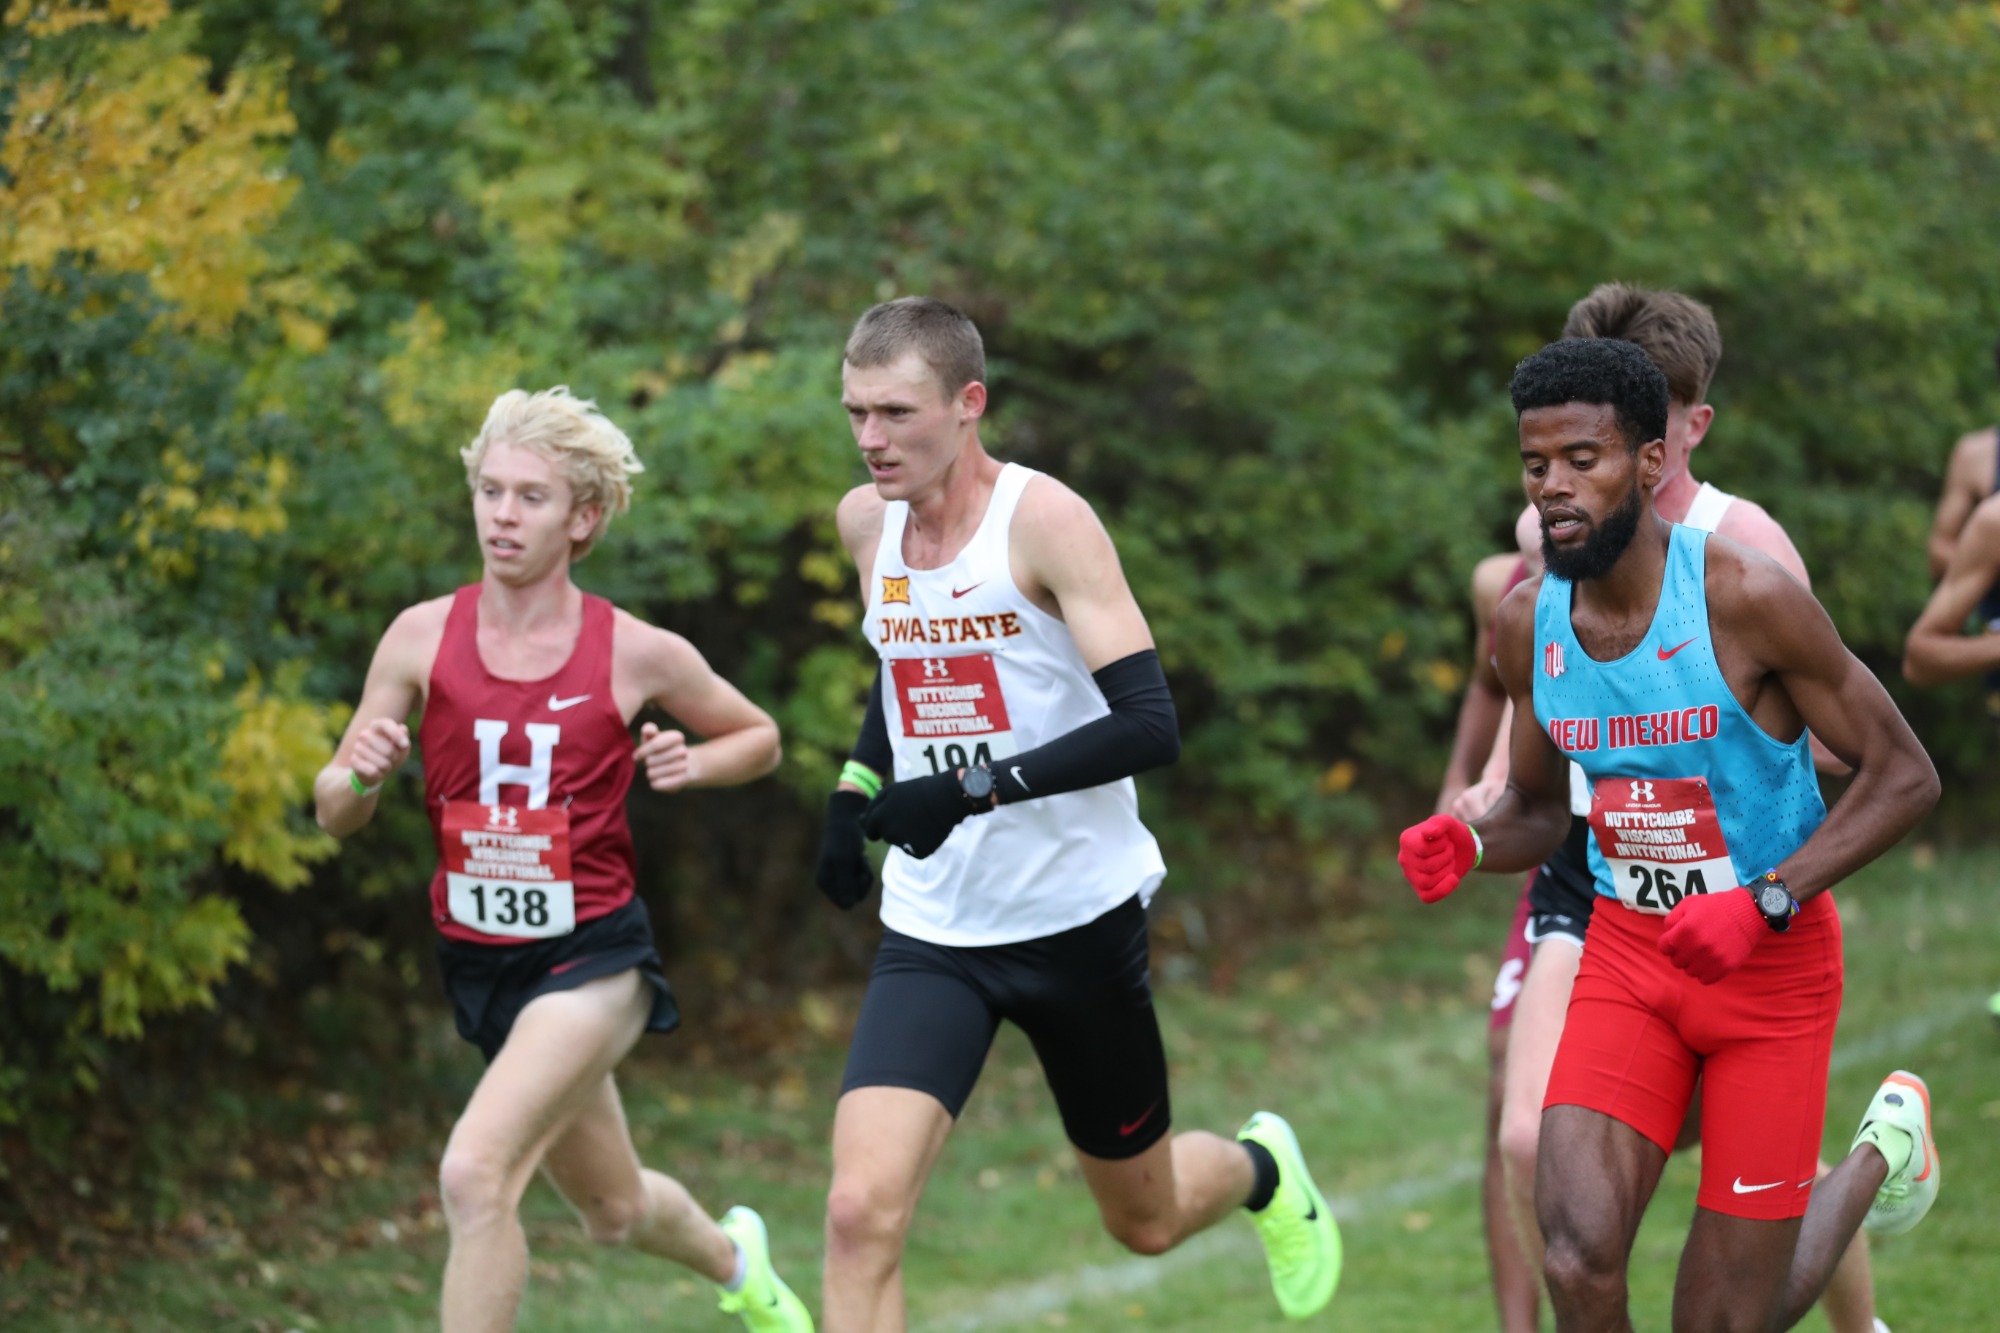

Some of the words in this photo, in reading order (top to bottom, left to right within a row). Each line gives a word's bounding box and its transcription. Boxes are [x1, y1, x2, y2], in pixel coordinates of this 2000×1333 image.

[878, 617, 927, 644] OWA
[929, 611, 1022, 643] STATE
[1549, 718, 1599, 752] NEW
[1608, 704, 1719, 749] MEXICO
[474, 718, 560, 810] H
[1604, 808, 1696, 828] NUTTYCOMBE
[1615, 827, 1687, 844] WISCONSIN
[1609, 842, 1707, 860] INVITATIONAL
[470, 884, 549, 927] 138
[1629, 865, 1708, 910] 264
